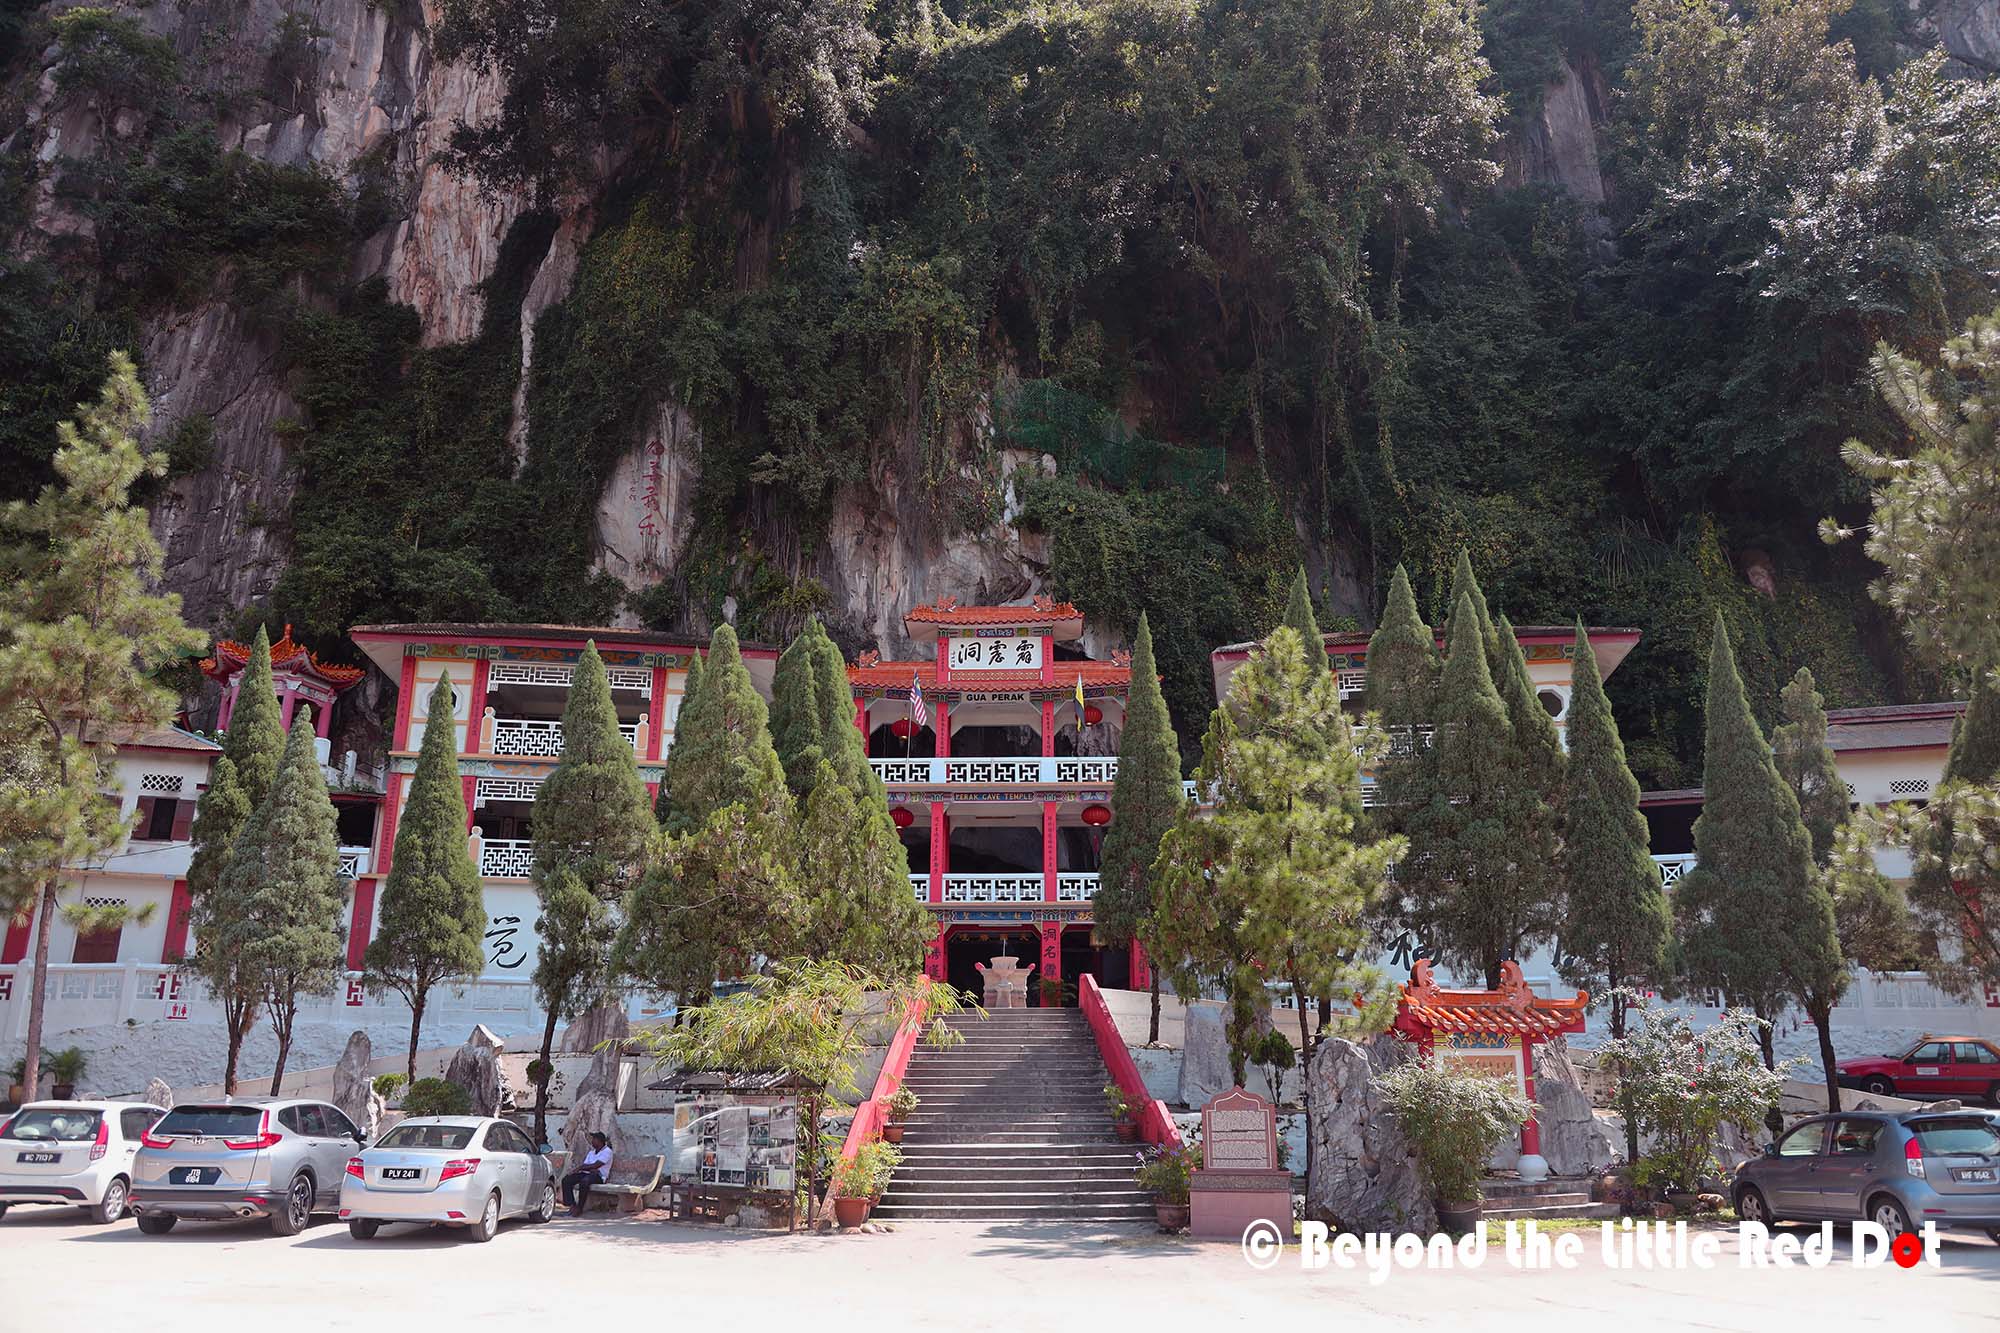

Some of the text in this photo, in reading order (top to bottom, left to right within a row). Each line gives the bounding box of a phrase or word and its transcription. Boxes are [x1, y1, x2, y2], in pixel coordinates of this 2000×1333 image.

[966, 693, 1025, 702] GUA PERAK
[982, 793, 1001, 801] CAVE
[402, 1169, 415, 1178] 241
